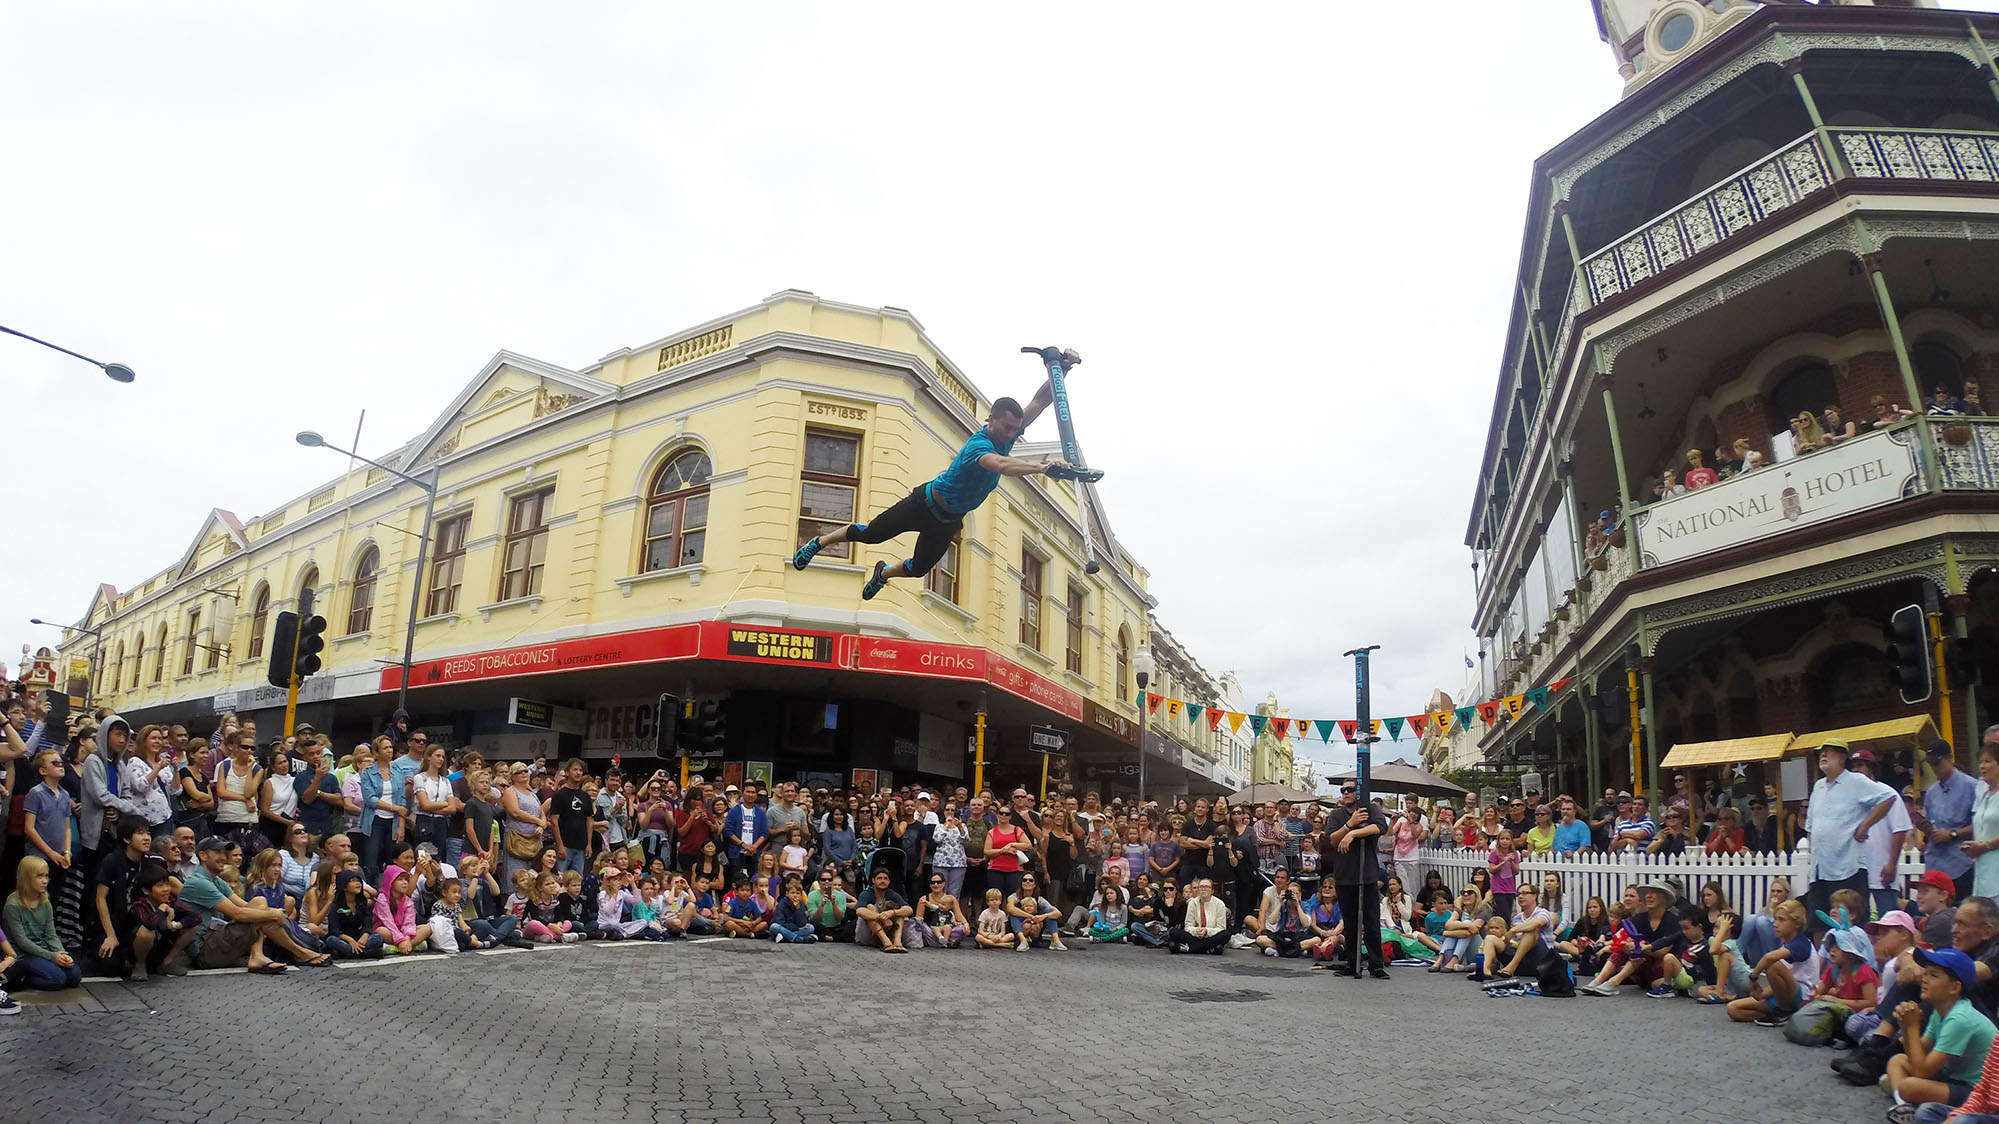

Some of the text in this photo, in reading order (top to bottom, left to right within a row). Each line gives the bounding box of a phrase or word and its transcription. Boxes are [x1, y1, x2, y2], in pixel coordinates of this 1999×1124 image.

[1657, 458, 1892, 543] NATIONAL HOTEL
[732, 630, 814, 647] WESTERN
[444, 658, 476, 679] REEDS
[479, 648, 557, 675] TOBACCONIST
[563, 654, 593, 665] LOTTERY
[594, 651, 622, 662] CENTRE
[757, 644, 814, 660] UNION
[920, 650, 975, 670] drinks
[1008, 671, 1024, 688] gifts
[1029, 681, 1048, 698] phone
[1049, 691, 1064, 706] cards
[1150, 697, 1218, 724] WEST
[1253, 718, 1308, 733] END
[1344, 692, 1545, 736] WEEKENDER
[1034, 733, 1046, 745] ONE
